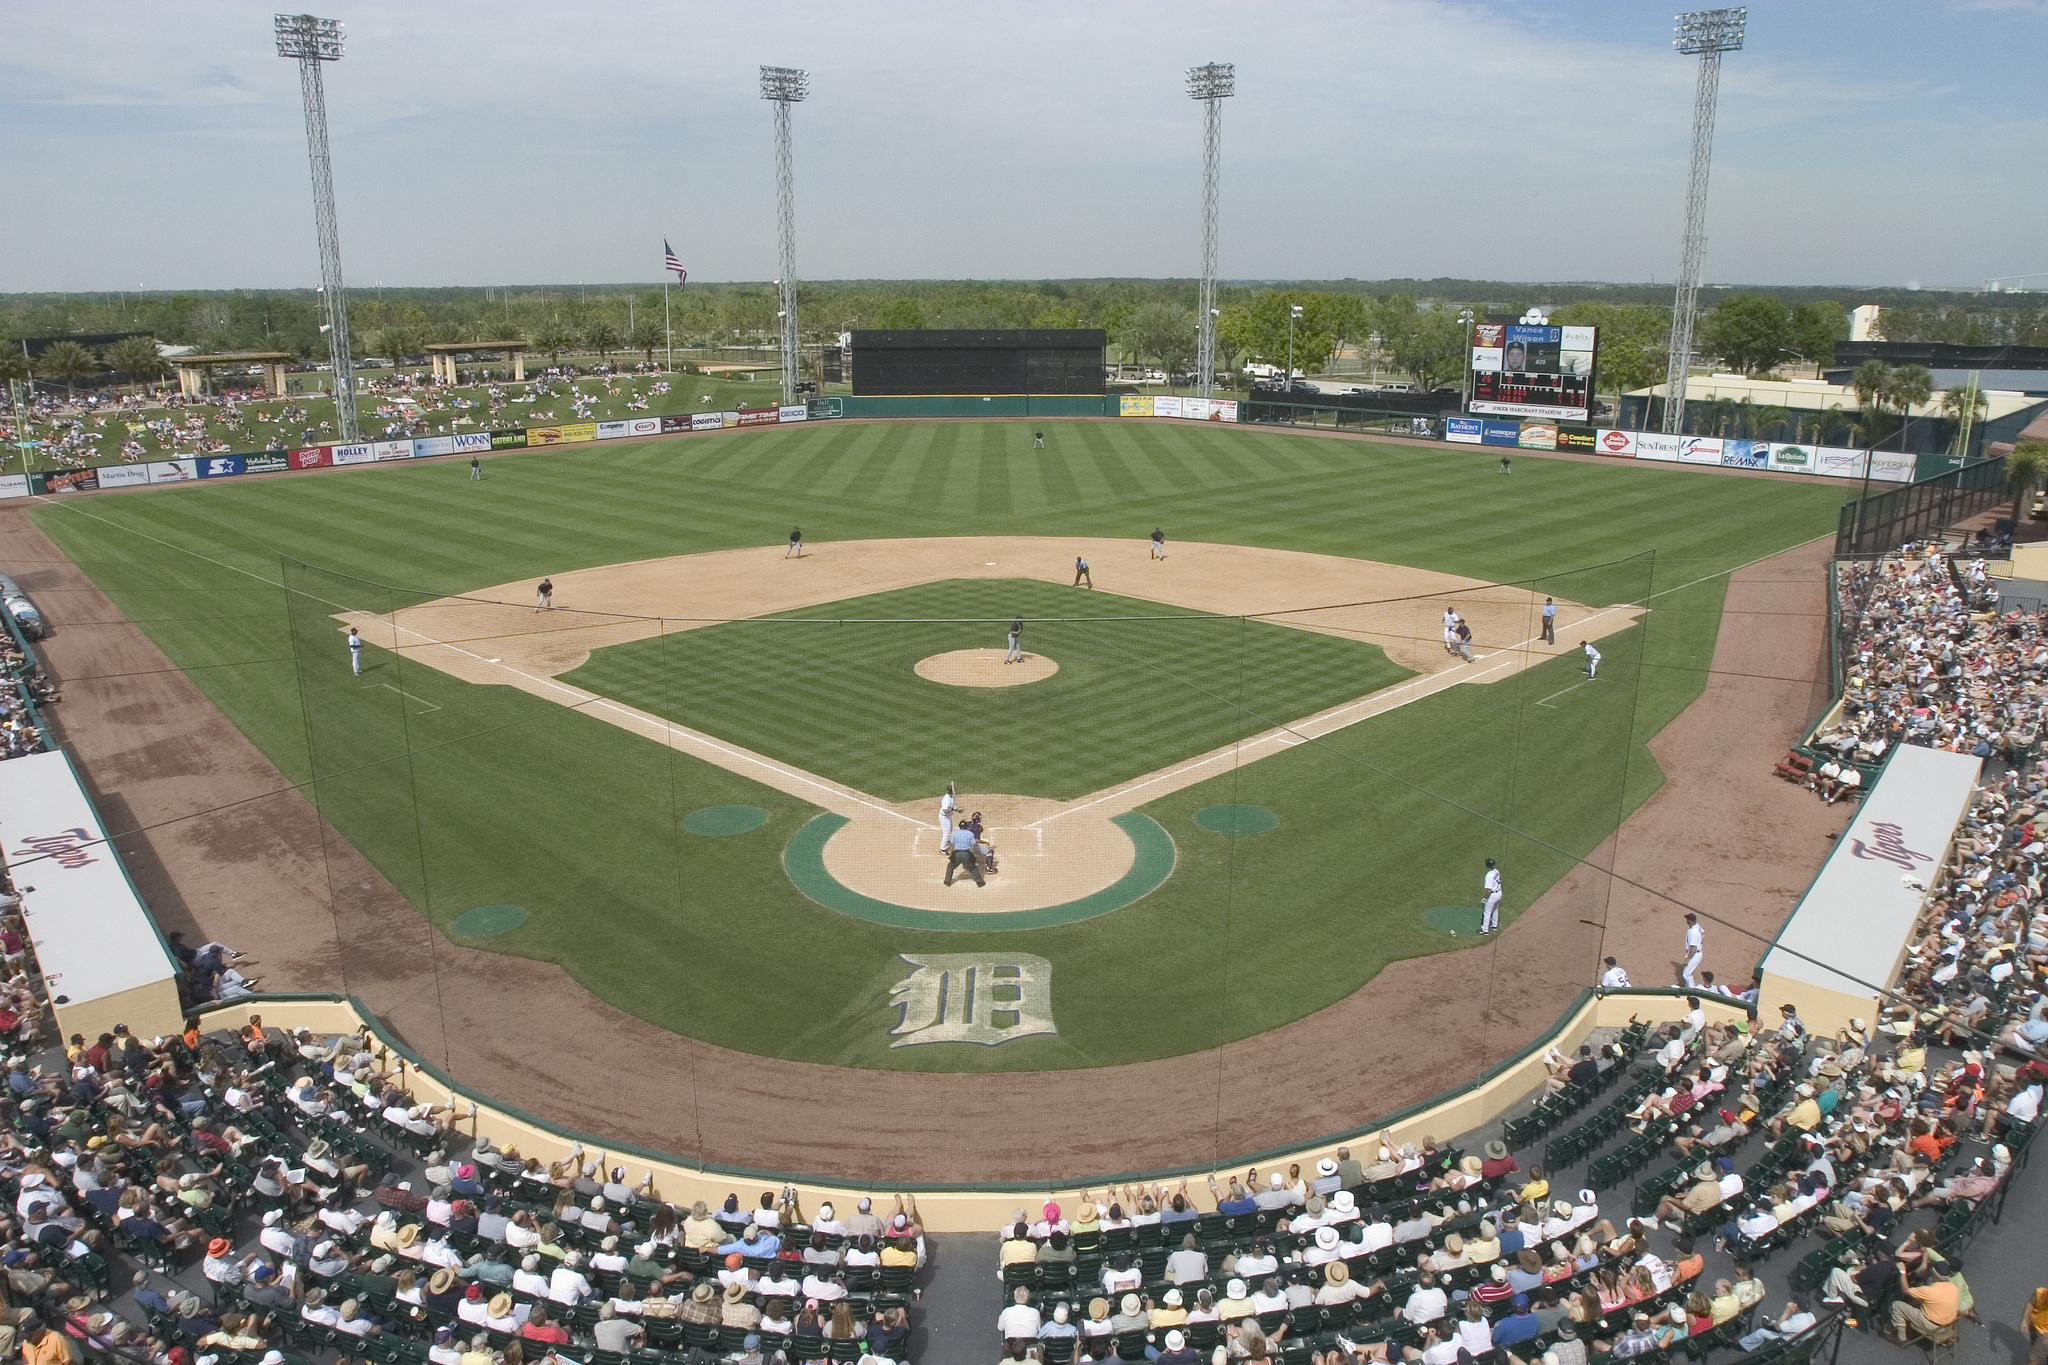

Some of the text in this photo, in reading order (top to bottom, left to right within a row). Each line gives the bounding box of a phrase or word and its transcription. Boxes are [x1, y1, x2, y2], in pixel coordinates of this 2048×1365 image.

[1515, 326, 1544, 334] Vance
[1513, 334, 1544, 342] Wilson
[1471, 402, 1485, 411] Tigers
[780, 409, 805, 418] GEICO
[600, 422, 624, 430] Computer
[1450, 422, 1479, 431] BAYMONT
[454, 434, 489, 447] WONN
[492, 435, 526, 445] GATORLAND
[1569, 434, 1595, 442] Comfort
[337, 447, 368, 457] HOLLEY
[1786, 452, 1805, 461] Quinta
[245, 456, 287, 466] Holiday Inn
[1723, 455, 1759, 467] RE/MAX
[127, 470, 145, 478] Drug
[46, 469, 95, 491] HOOTERS
[11, 827, 99, 869] Tigers
[1850, 820, 1934, 871] Tigers
